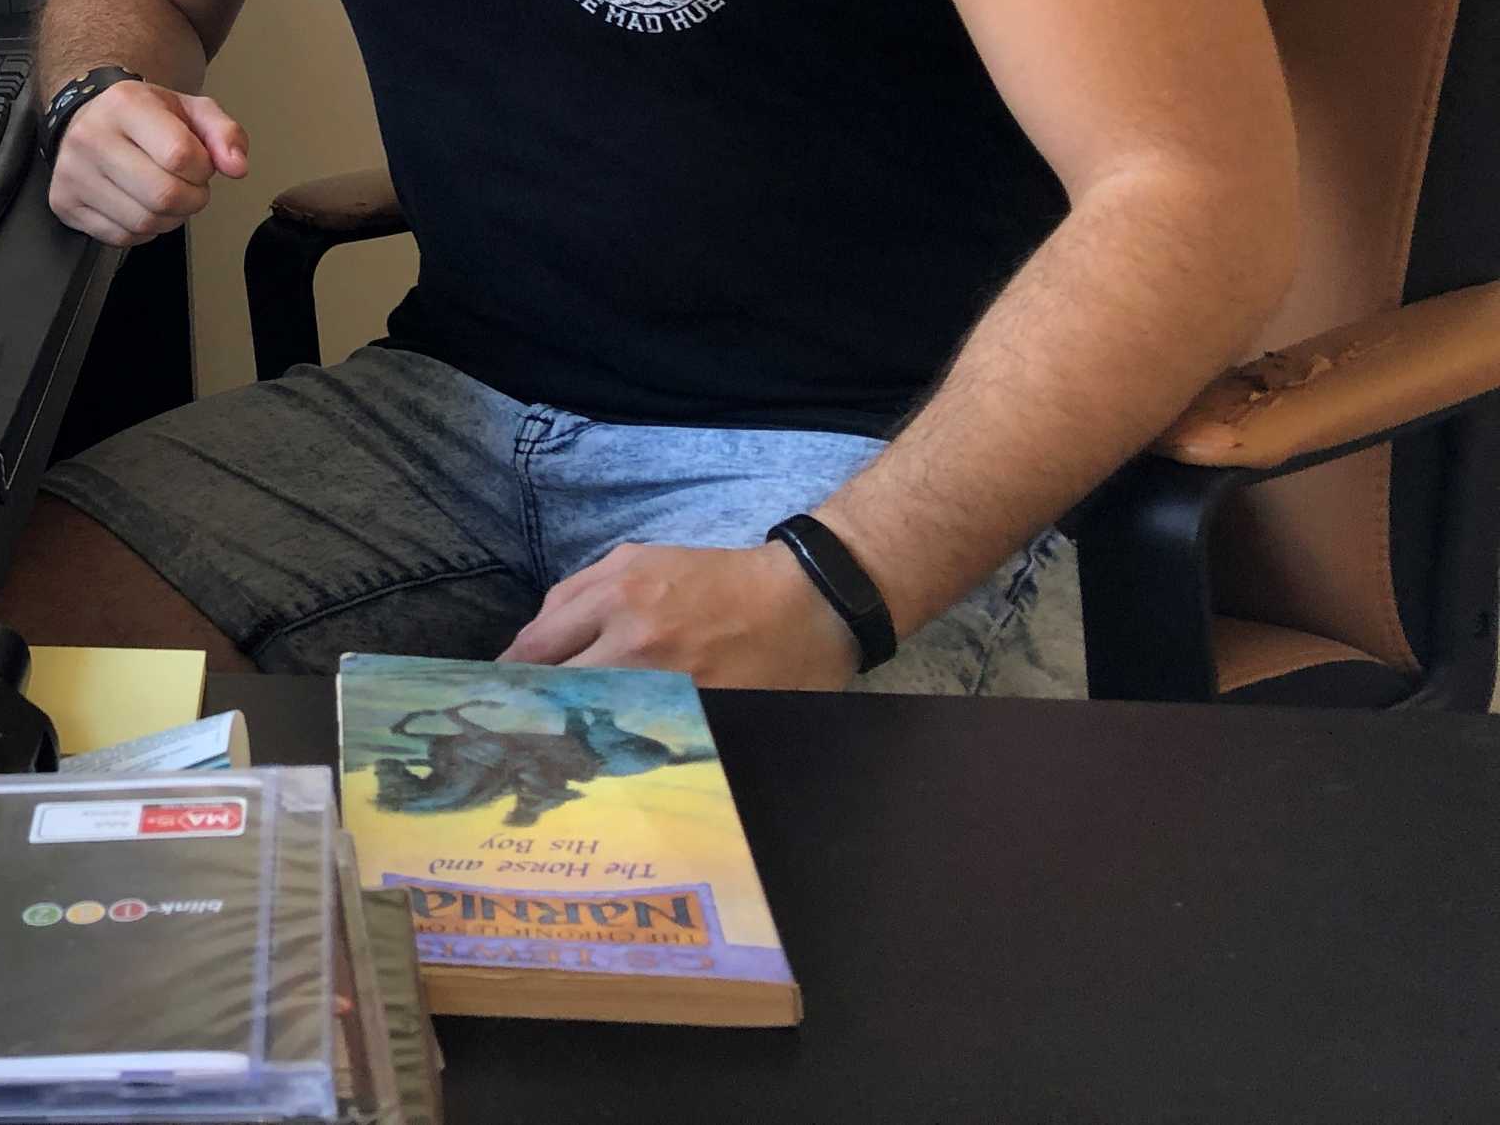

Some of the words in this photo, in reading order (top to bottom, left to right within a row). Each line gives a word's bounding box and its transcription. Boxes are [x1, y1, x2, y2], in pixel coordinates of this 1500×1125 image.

[605, 4, 663, 33] MAD
[188, 812, 229, 826] MA
[479, 833, 533, 854] Boy
[550, 838, 599, 855] His
[428, 857, 483, 874] and
[604, 862, 658, 879] The
[160, 898, 223, 916] blink
